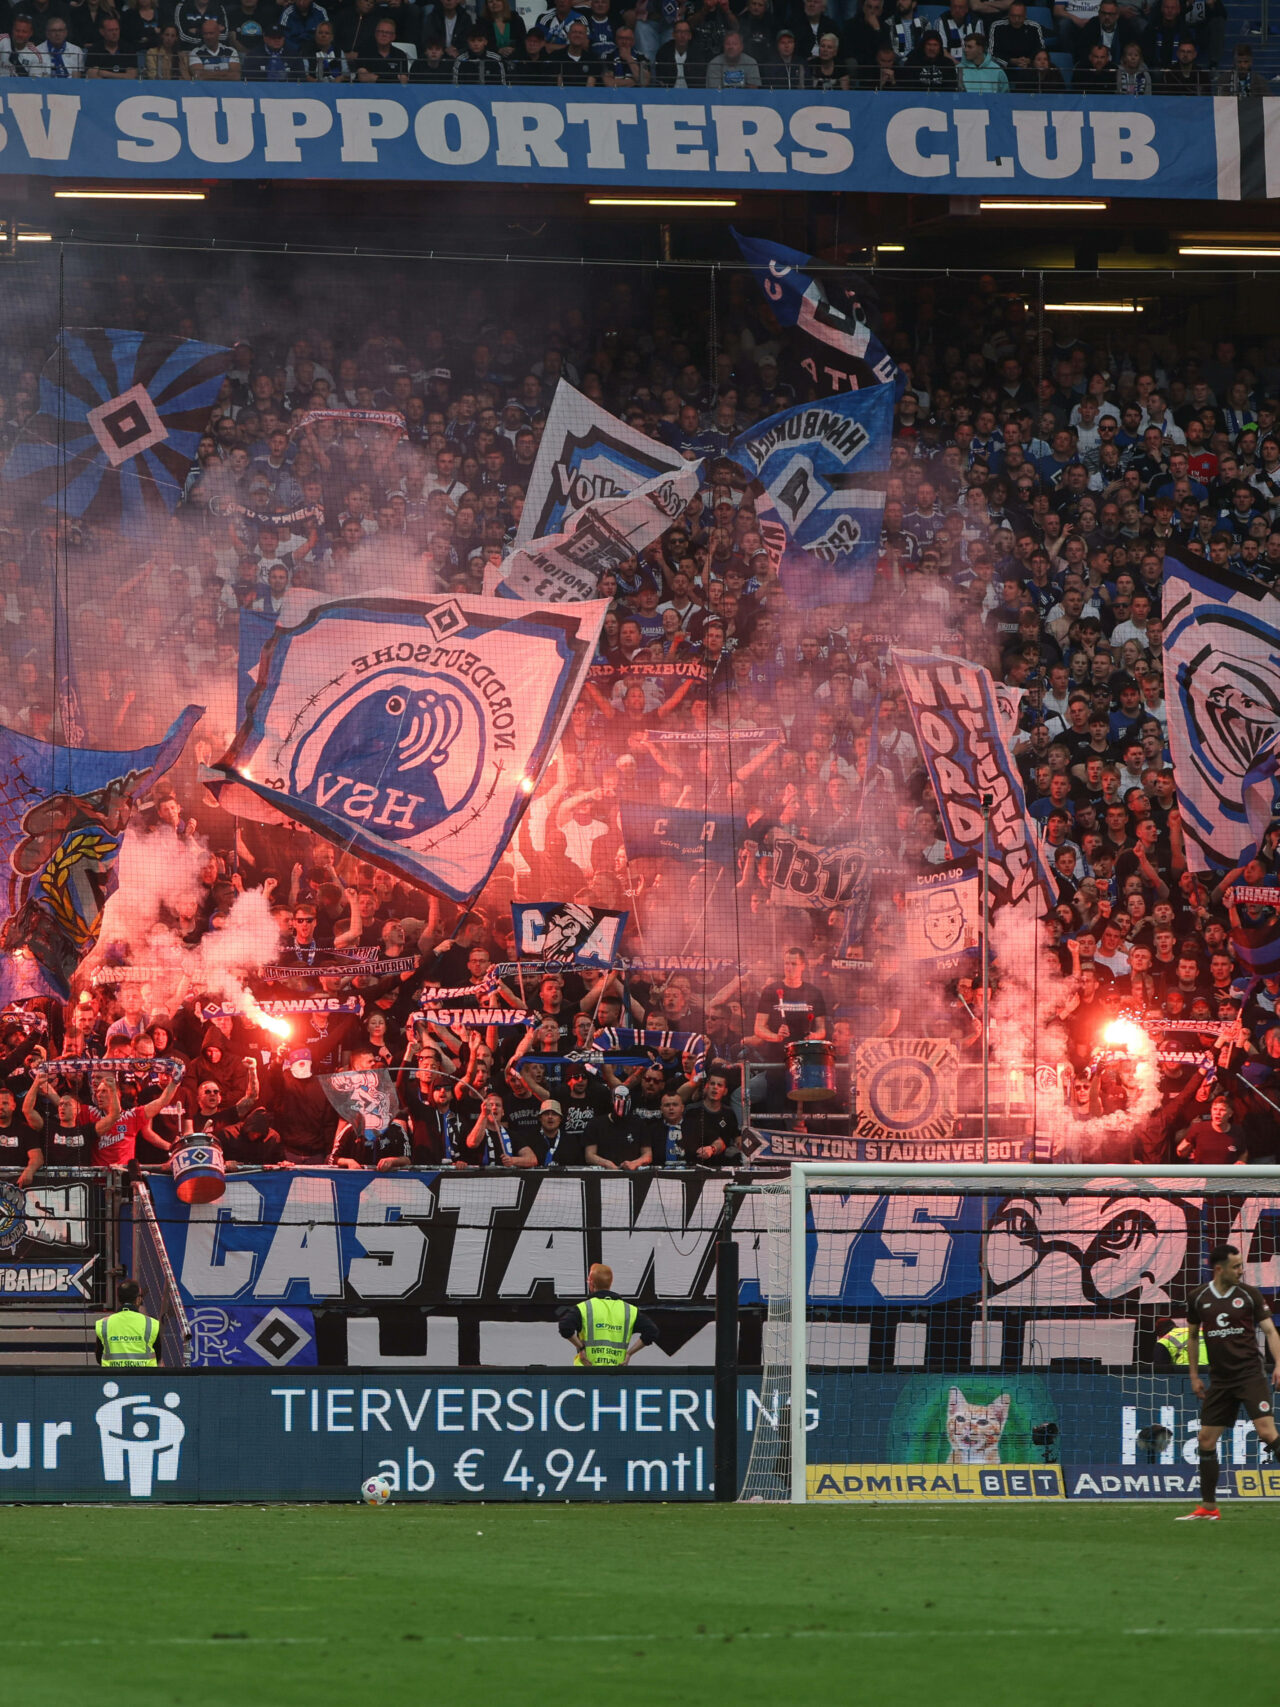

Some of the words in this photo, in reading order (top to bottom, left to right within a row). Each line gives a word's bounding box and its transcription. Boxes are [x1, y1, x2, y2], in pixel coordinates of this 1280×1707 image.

[116, 95, 853, 175] SUPPORTERS
[886, 106, 1160, 181] CLUB
[865, 634, 901, 642] ERBY
[631, 662, 708, 681] TRIBUNE
[771, 838, 868, 903] 1312
[916, 872, 948, 886] turn
[949, 866, 964, 879] up
[520, 908, 548, 956] C
[575, 915, 621, 963] A
[936, 957, 960, 971] hsv
[221, 997, 340, 1014] CATAWAYS
[412, 1008, 528, 1025] CASTAWAYS
[856, 1040, 937, 1080] SEKTION
[884, 1076, 923, 1112] 12
[771, 1135, 858, 1160] SEKTION
[864, 1140, 1024, 1161] STADIONVERBOT
[24, 1184, 90, 1248] SH
[180, 1173, 966, 1301] CASTAWAYS
[1207, 1326, 1246, 1338] congstar
[271, 1388, 820, 1434] TIERVERSICHERUNG
[375, 1447, 436, 1492] ab
[453, 1448, 485, 1492] €
[503, 1448, 607, 1498] 4,94
[626, 1446, 716, 1492] mtl.
[815, 1473, 974, 1494] ADMIRAL
[984, 1474, 1056, 1493] BET
